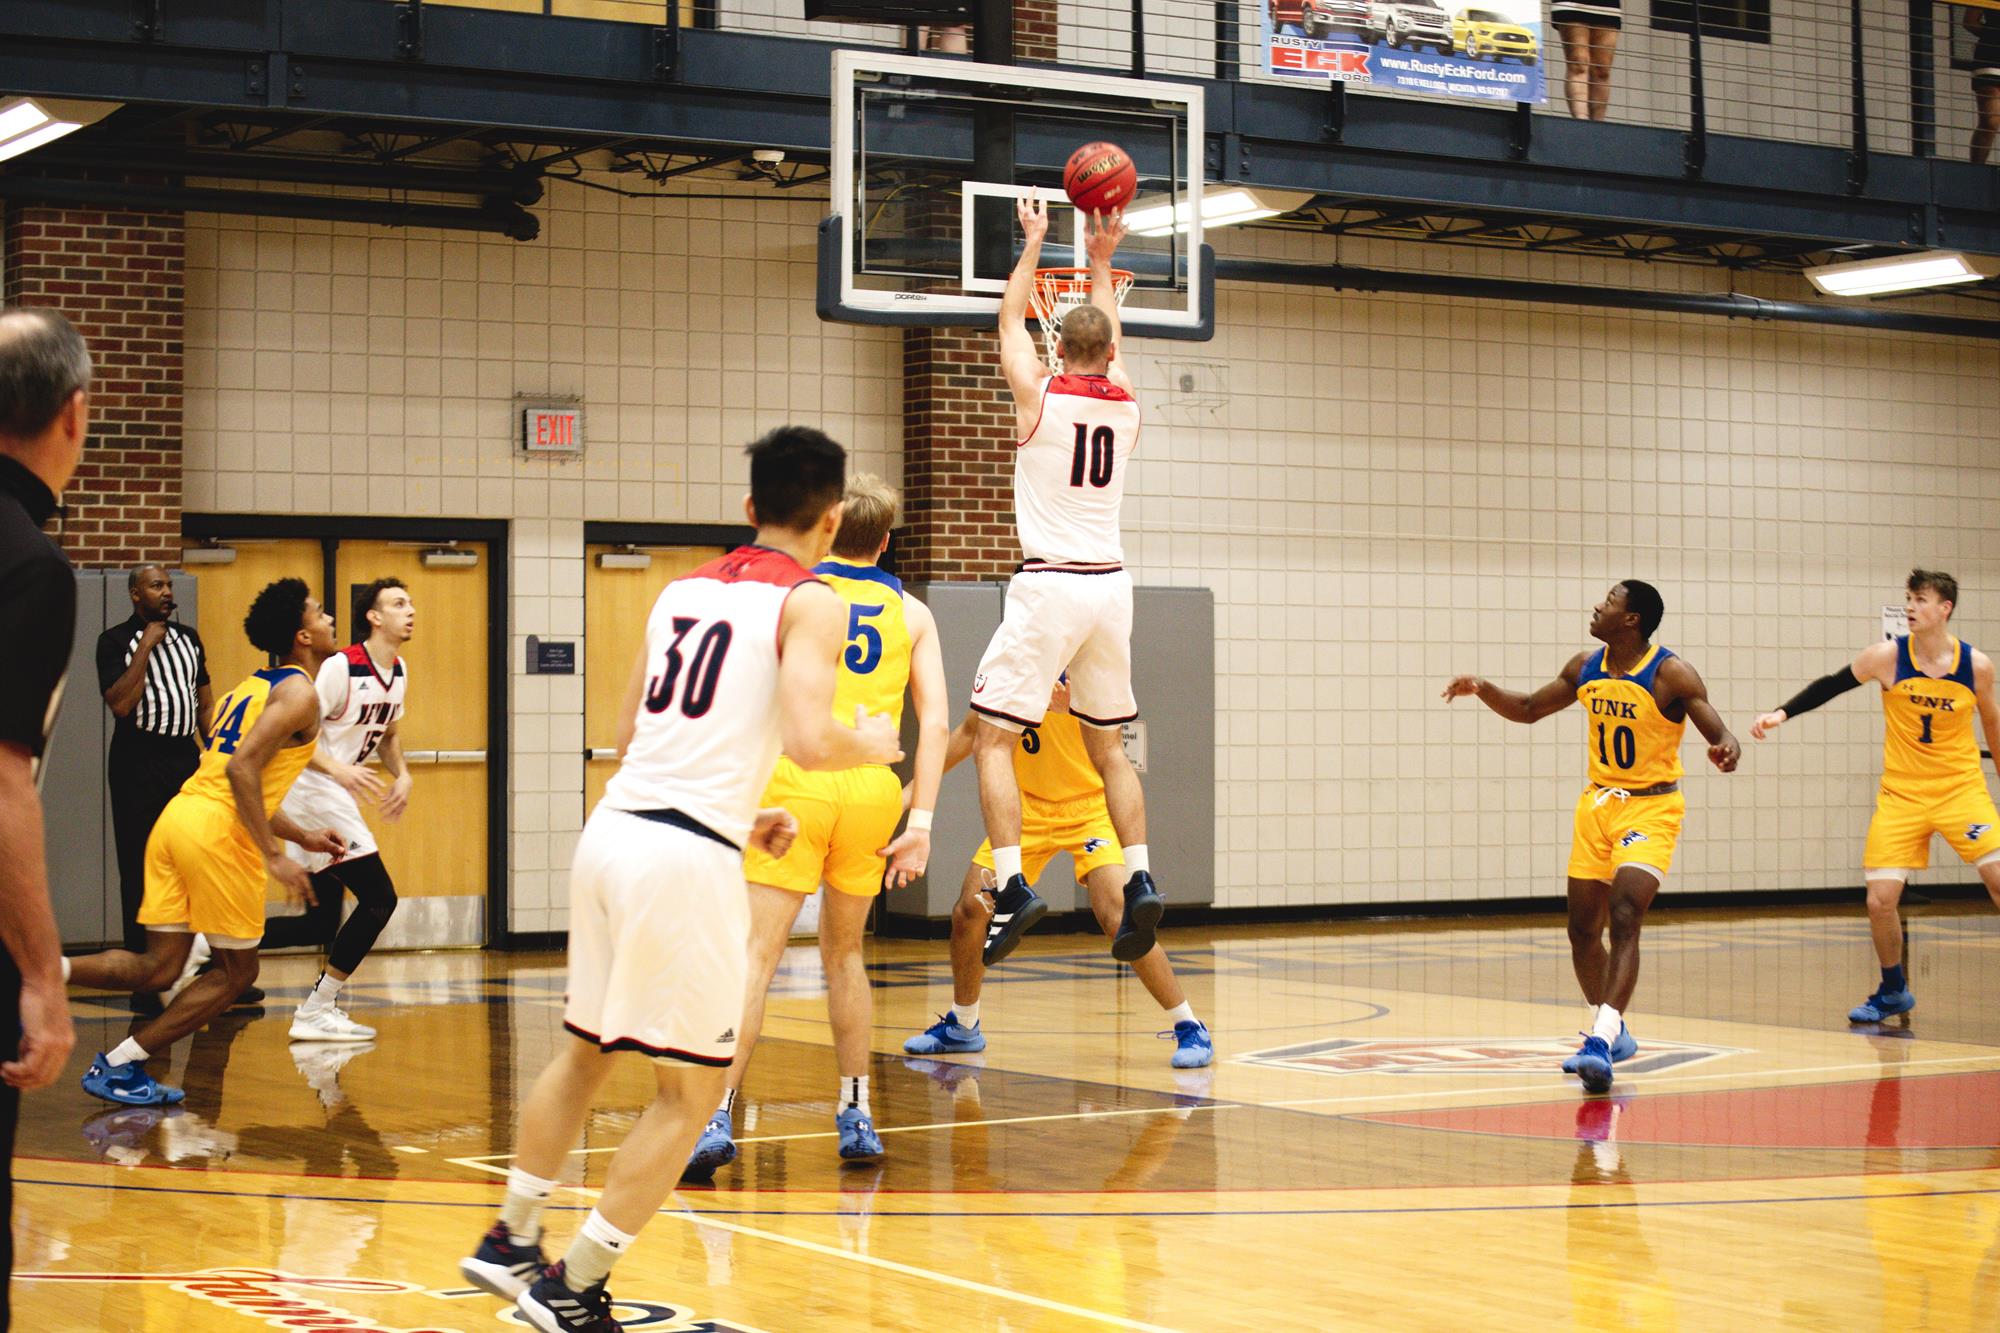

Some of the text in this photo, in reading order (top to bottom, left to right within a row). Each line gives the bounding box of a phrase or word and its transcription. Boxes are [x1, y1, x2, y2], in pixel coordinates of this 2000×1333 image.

[1271, 36, 1320, 48] RUSTY
[1272, 46, 1370, 75] ECK
[1380, 57, 1527, 84] www.RustyEckFord.com
[536, 415, 575, 446] EXIT
[1070, 422, 1114, 488] 10
[845, 603, 885, 674] 5
[645, 616, 733, 719] 30
[1591, 698, 1637, 720] UNK
[1910, 694, 1955, 712] UNK
[1919, 714, 1933, 743] 1
[1597, 722, 1636, 770] 10
